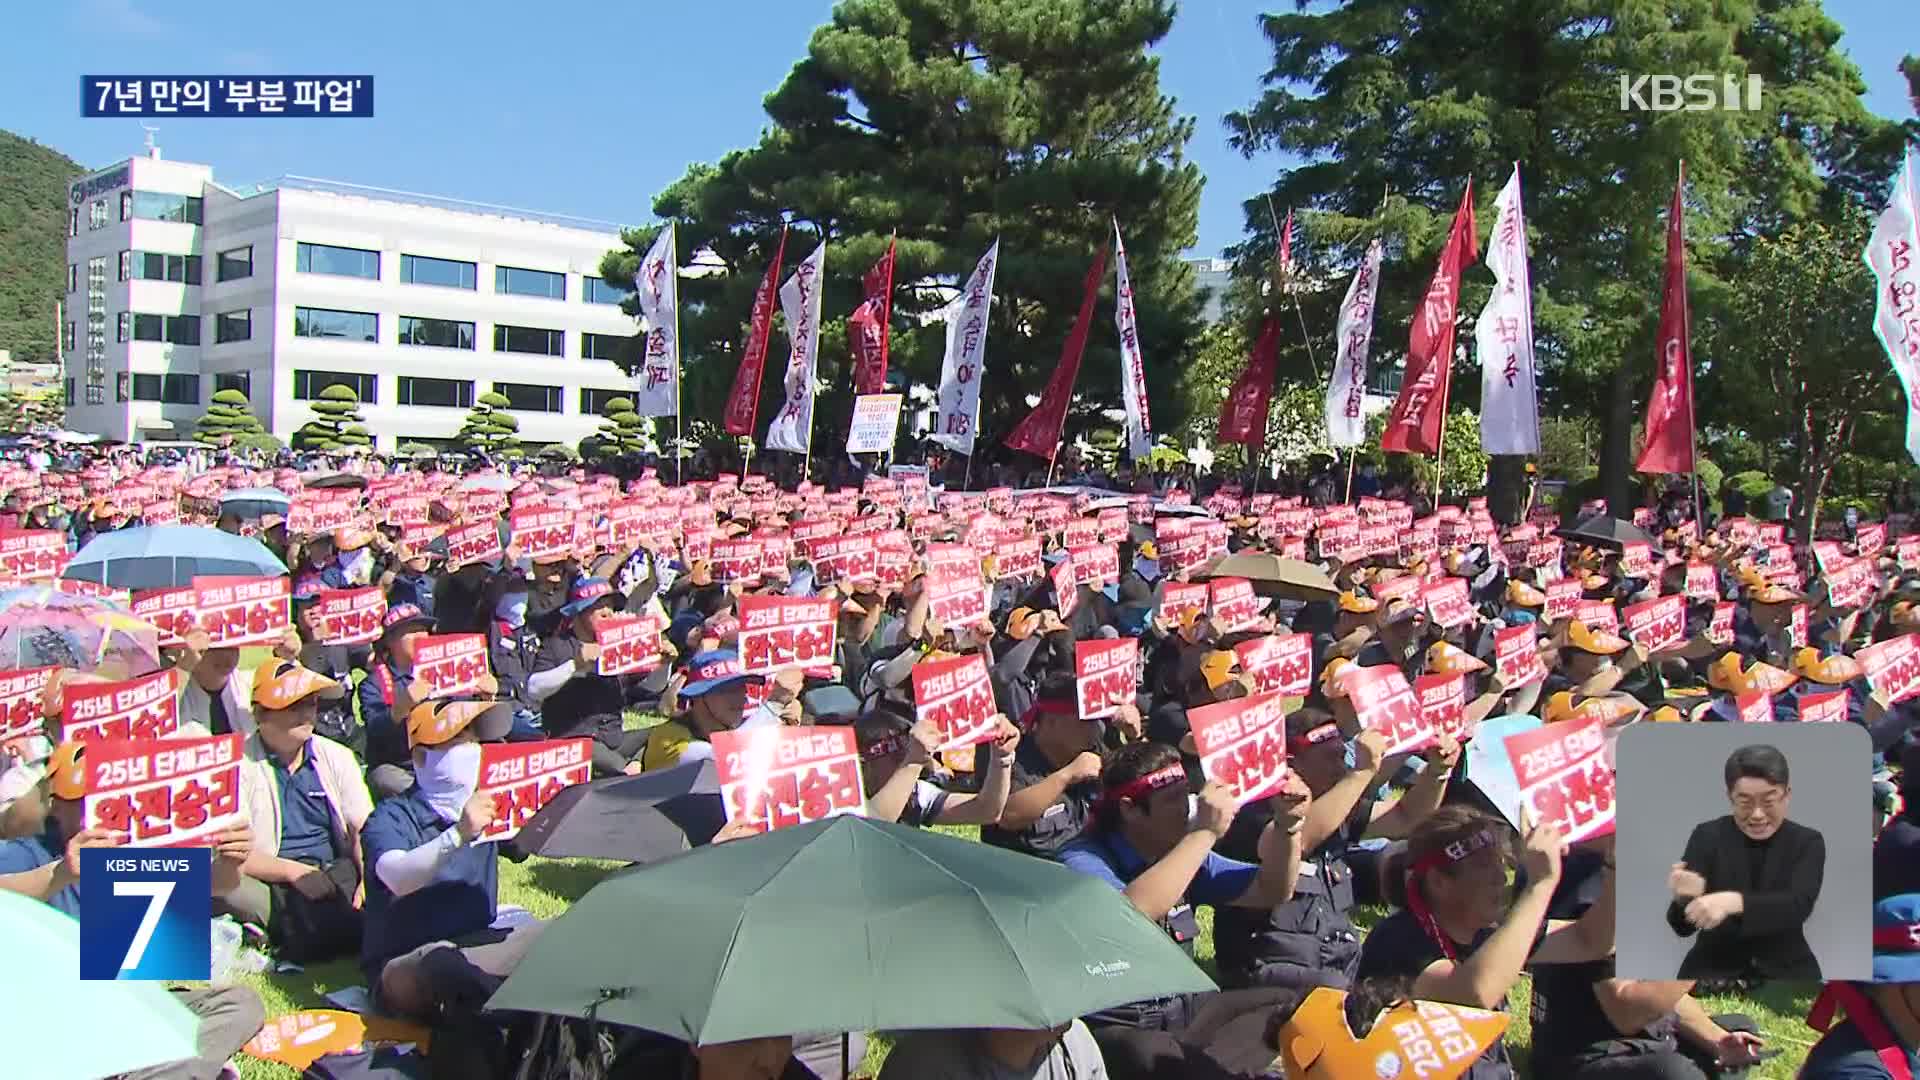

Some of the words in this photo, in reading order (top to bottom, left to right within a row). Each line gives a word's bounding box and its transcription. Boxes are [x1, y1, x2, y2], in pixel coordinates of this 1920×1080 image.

[201, 586, 233, 606] 25년
[746, 609, 780, 627] 25년
[782, 602, 831, 623] 단체교섭
[743, 622, 835, 671] 완전승리
[72, 696, 113, 721] 25년
[115, 673, 170, 709] 단체교섭
[920, 670, 955, 699] 25년
[779, 734, 847, 764] 단체교섭
[1201, 714, 1242, 749] 25년
[96, 755, 149, 788] 25년
[153, 741, 234, 777] 단체교섭
[486, 758, 526, 785] 25년
[527, 742, 584, 775] 단체교섭
[1519, 741, 1565, 779] 25년
[94, 766, 239, 846] 완전승리
